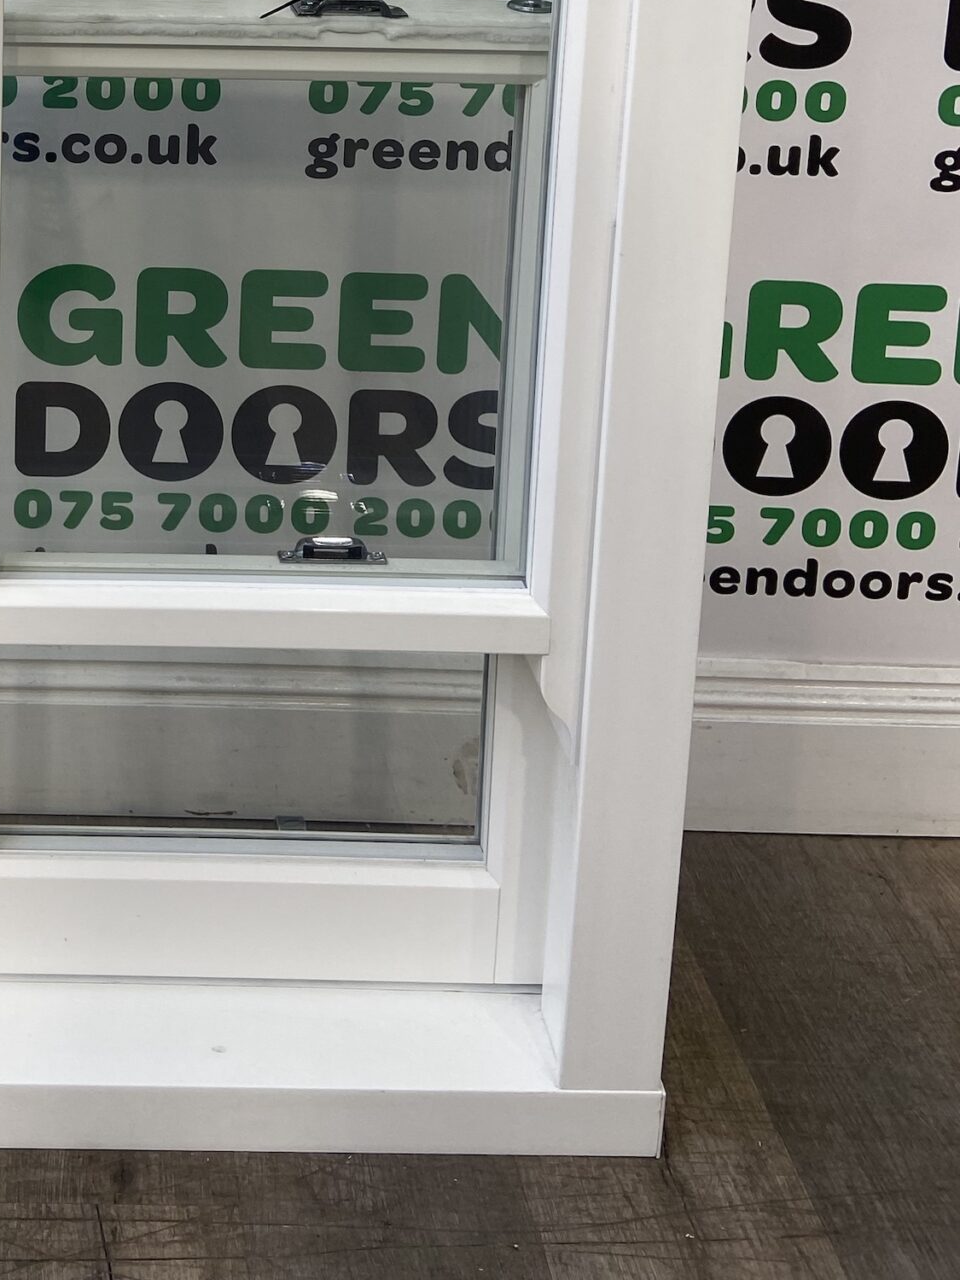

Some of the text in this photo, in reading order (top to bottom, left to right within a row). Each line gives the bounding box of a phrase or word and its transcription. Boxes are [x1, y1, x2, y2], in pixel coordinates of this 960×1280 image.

[17, 264, 502, 375] GREEN
[15, 381, 498, 488] DOORS
[14, 489, 495, 539] 075 7000 200
[760, 507, 936, 550] 7000
